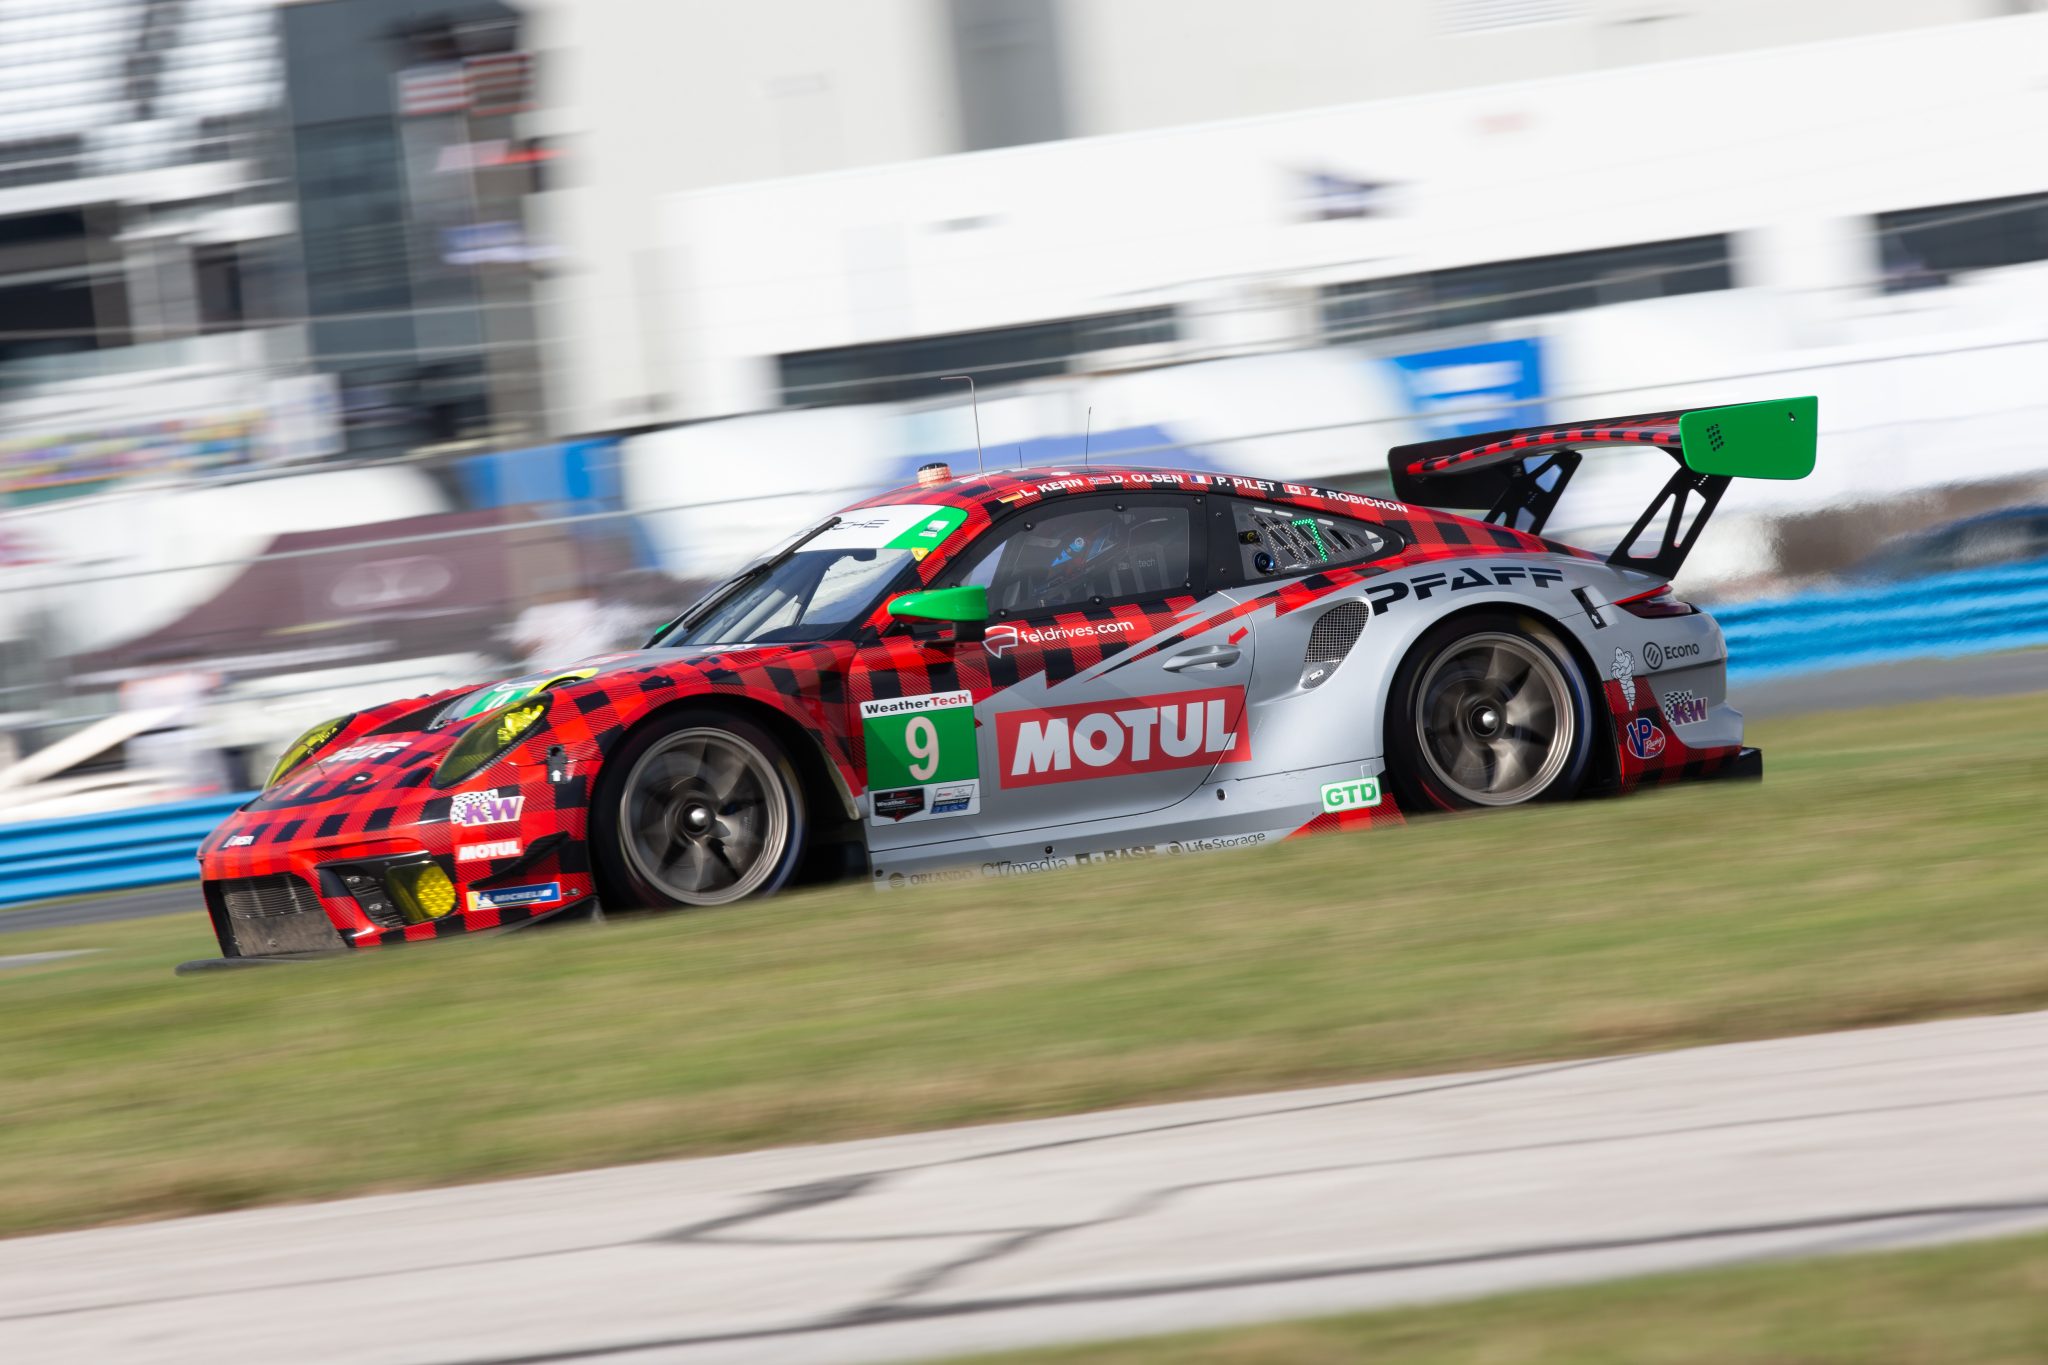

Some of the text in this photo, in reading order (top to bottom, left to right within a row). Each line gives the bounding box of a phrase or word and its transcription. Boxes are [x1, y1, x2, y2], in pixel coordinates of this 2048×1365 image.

[1020, 476, 1085, 498] L. KERN
[1111, 473, 1185, 485] D. OLSEN
[1216, 476, 1276, 493] P. PILET
[1310, 487, 1409, 514] Z. ROBICHON
[1364, 566, 1563, 616] PFAFF
[1020, 620, 1135, 643] feldrives.com
[1664, 643, 1700, 660] Econo
[865, 694, 968, 715] WeatherTech
[1672, 697, 1708, 727] KW
[905, 716, 940, 781] 9
[1010, 699, 1238, 776] MOTUL
[1626, 717, 1653, 758] VP
[1325, 782, 1377, 807] GTD
[464, 797, 520, 826] KW
[458, 840, 521, 861] MOTUL
[1186, 831, 1267, 853] LifeStorage
[910, 868, 974, 886] ORLANDO
[494, 888, 552, 902] MICHELIN
